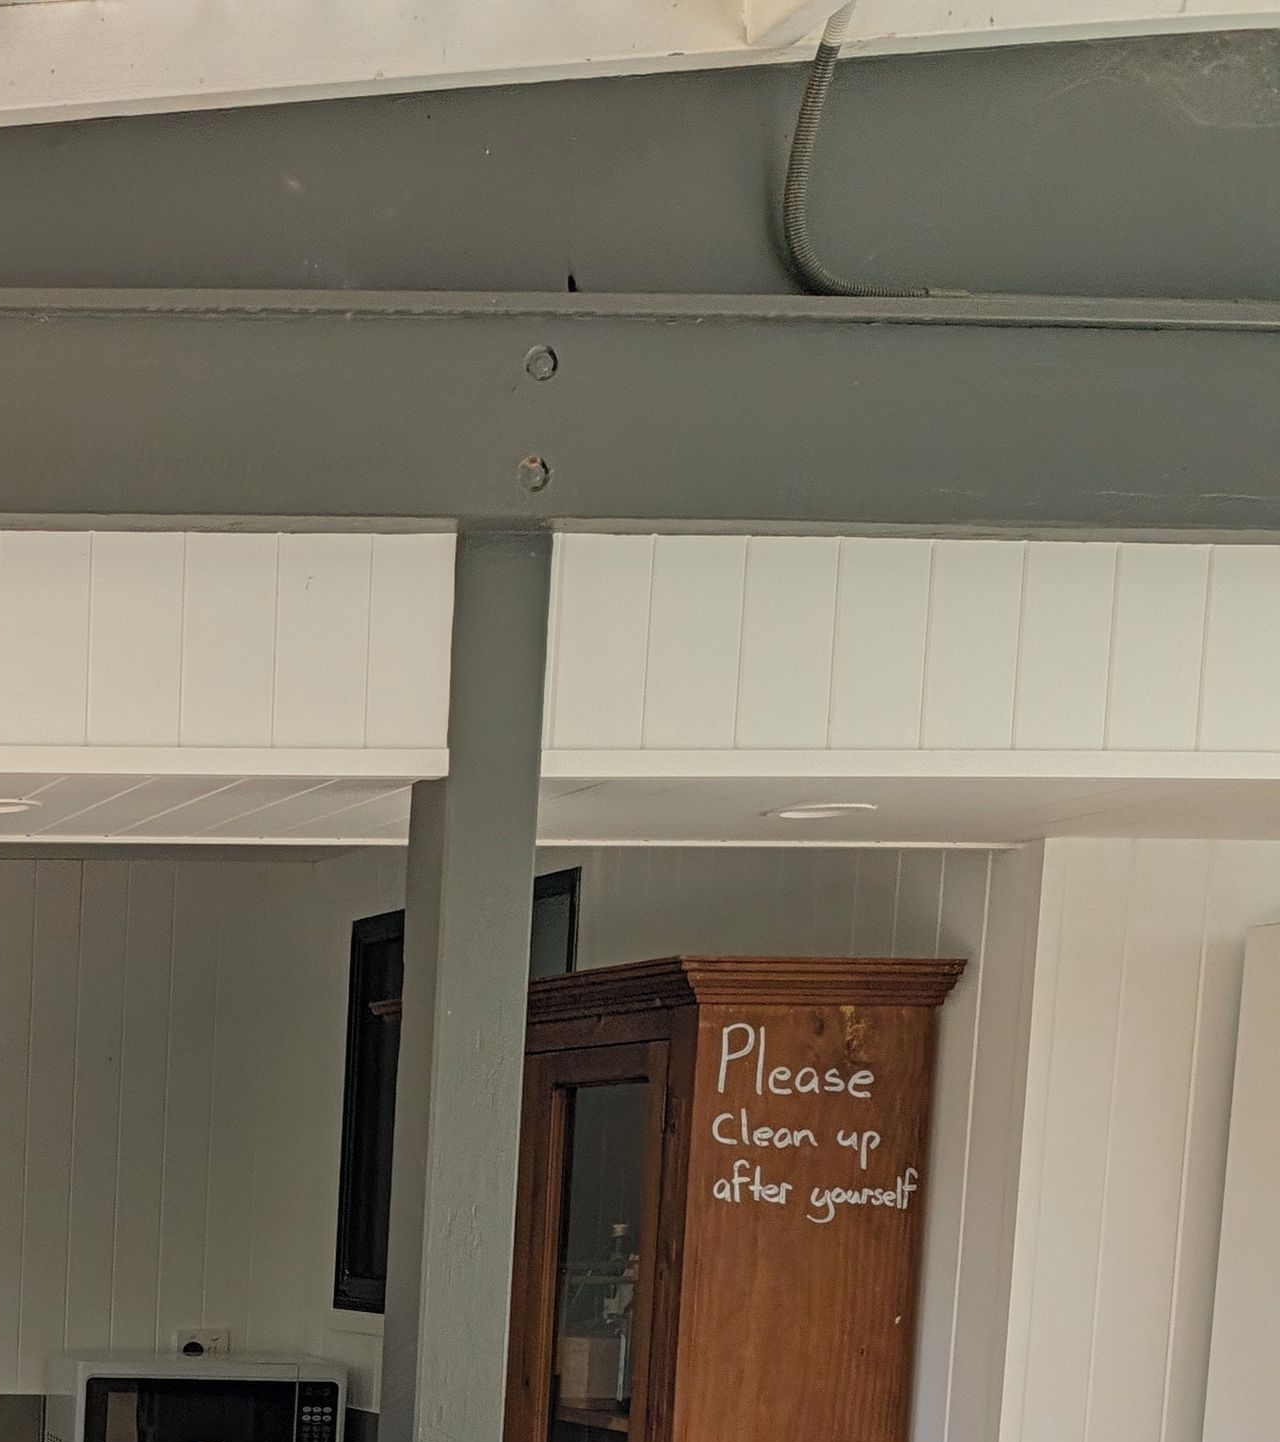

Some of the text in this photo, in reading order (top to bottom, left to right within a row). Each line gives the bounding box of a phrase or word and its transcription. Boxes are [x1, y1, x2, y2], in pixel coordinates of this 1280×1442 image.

[717, 1022, 875, 1098] Please
[837, 1129, 881, 1169] up
[713, 1159, 918, 1223] after yourself
